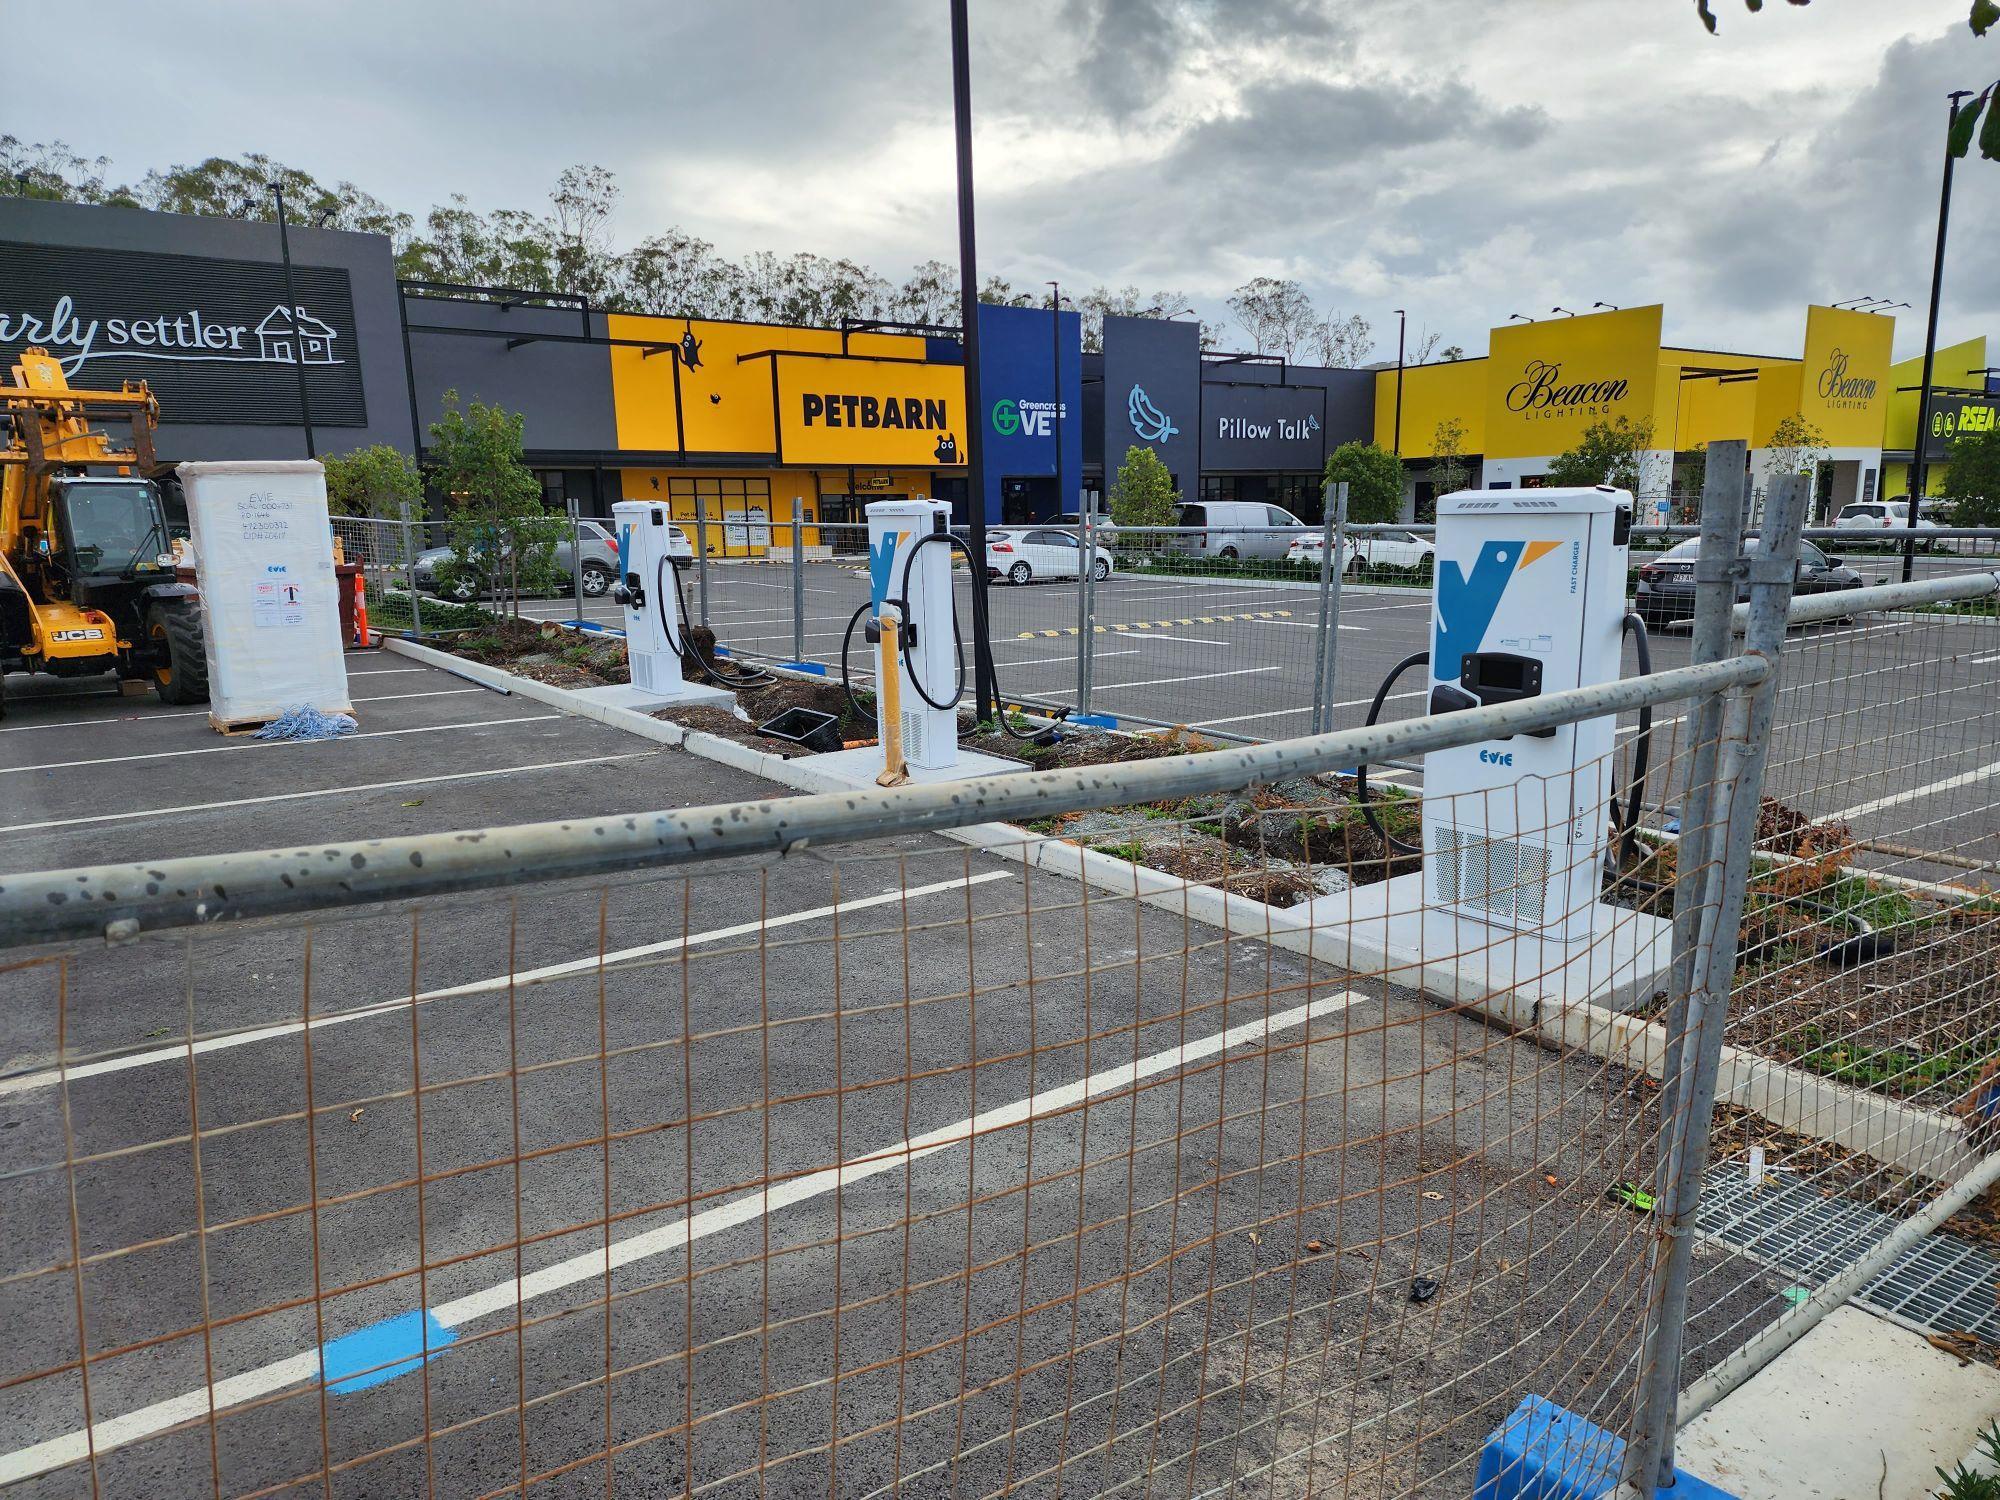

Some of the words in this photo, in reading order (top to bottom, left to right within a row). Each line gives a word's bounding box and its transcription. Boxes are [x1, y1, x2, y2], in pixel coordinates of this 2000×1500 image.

[107, 310, 247, 350] settler
[1506, 360, 1629, 412] Beacon
[1818, 347, 1876, 399] Beacon
[802, 393, 947, 430] PETBARN
[1525, 404, 1609, 420] LIGHTING
[1827, 400, 1867, 410] LIGHTING
[1957, 405, 1995, 432] RSEA
[1219, 417, 1272, 439] Pillow
[1277, 419, 1310, 440] Talk
[1571, 541, 1580, 576] CHARGER
[52, 630, 103, 641] JCB
